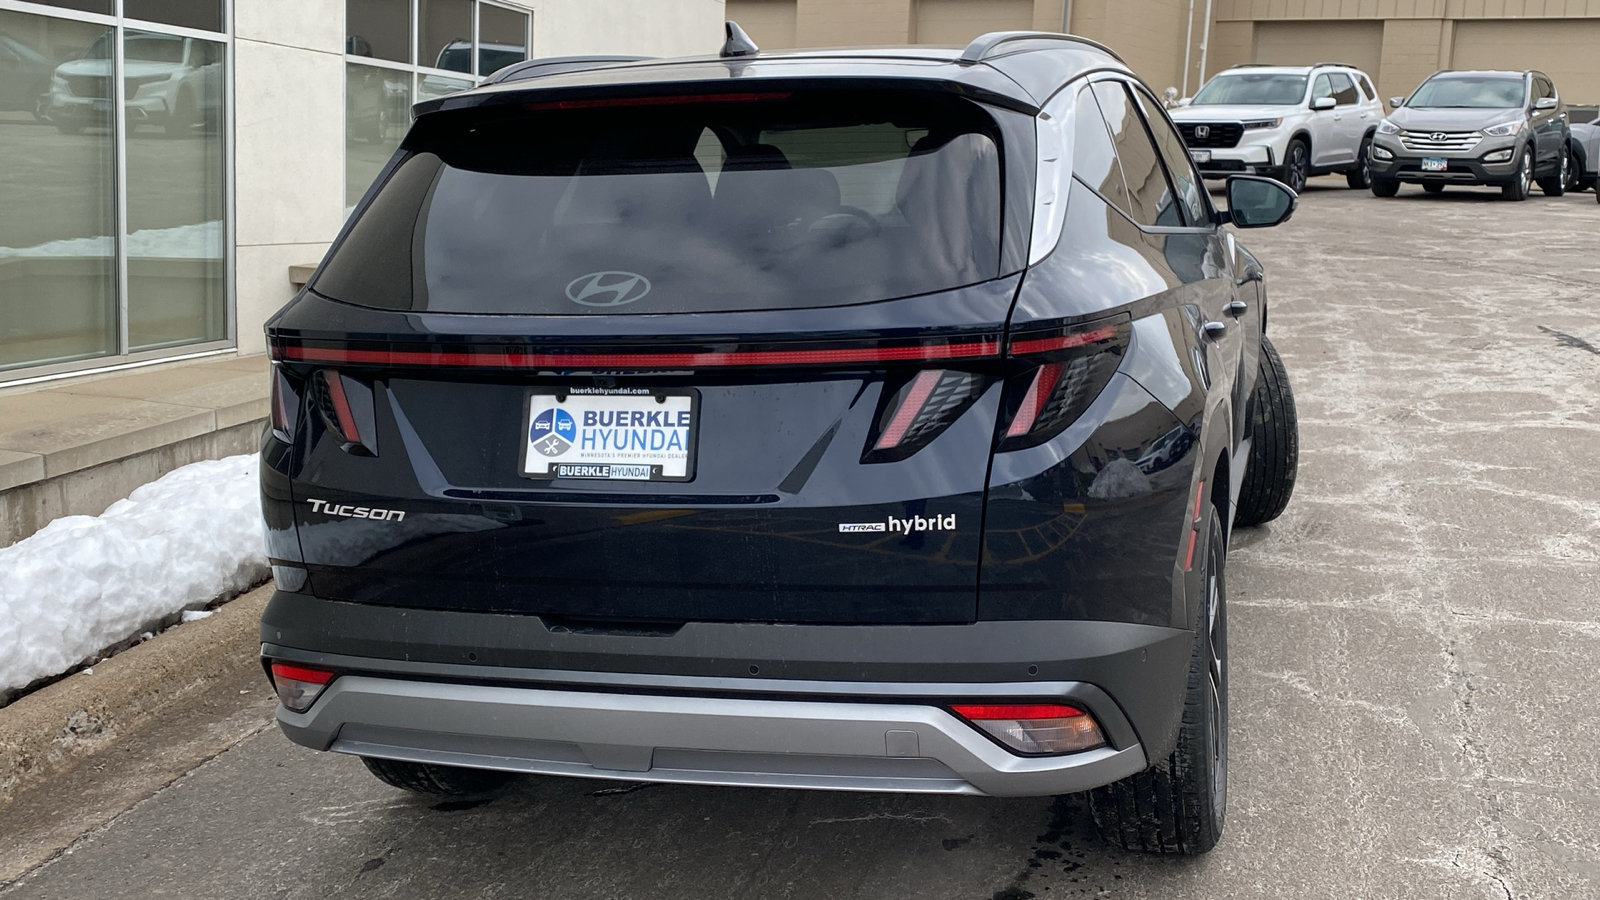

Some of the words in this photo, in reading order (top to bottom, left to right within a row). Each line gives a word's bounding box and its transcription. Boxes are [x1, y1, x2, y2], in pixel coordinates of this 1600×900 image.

[570, 387, 650, 395] buerklehyundai.com
[583, 410, 690, 427] BUERKLE
[581, 429, 689, 450] HYUNDAI
[559, 465, 610, 476] BUERKLE
[611, 466, 649, 477] HYUNDAI
[888, 514, 956, 535] hybrid
